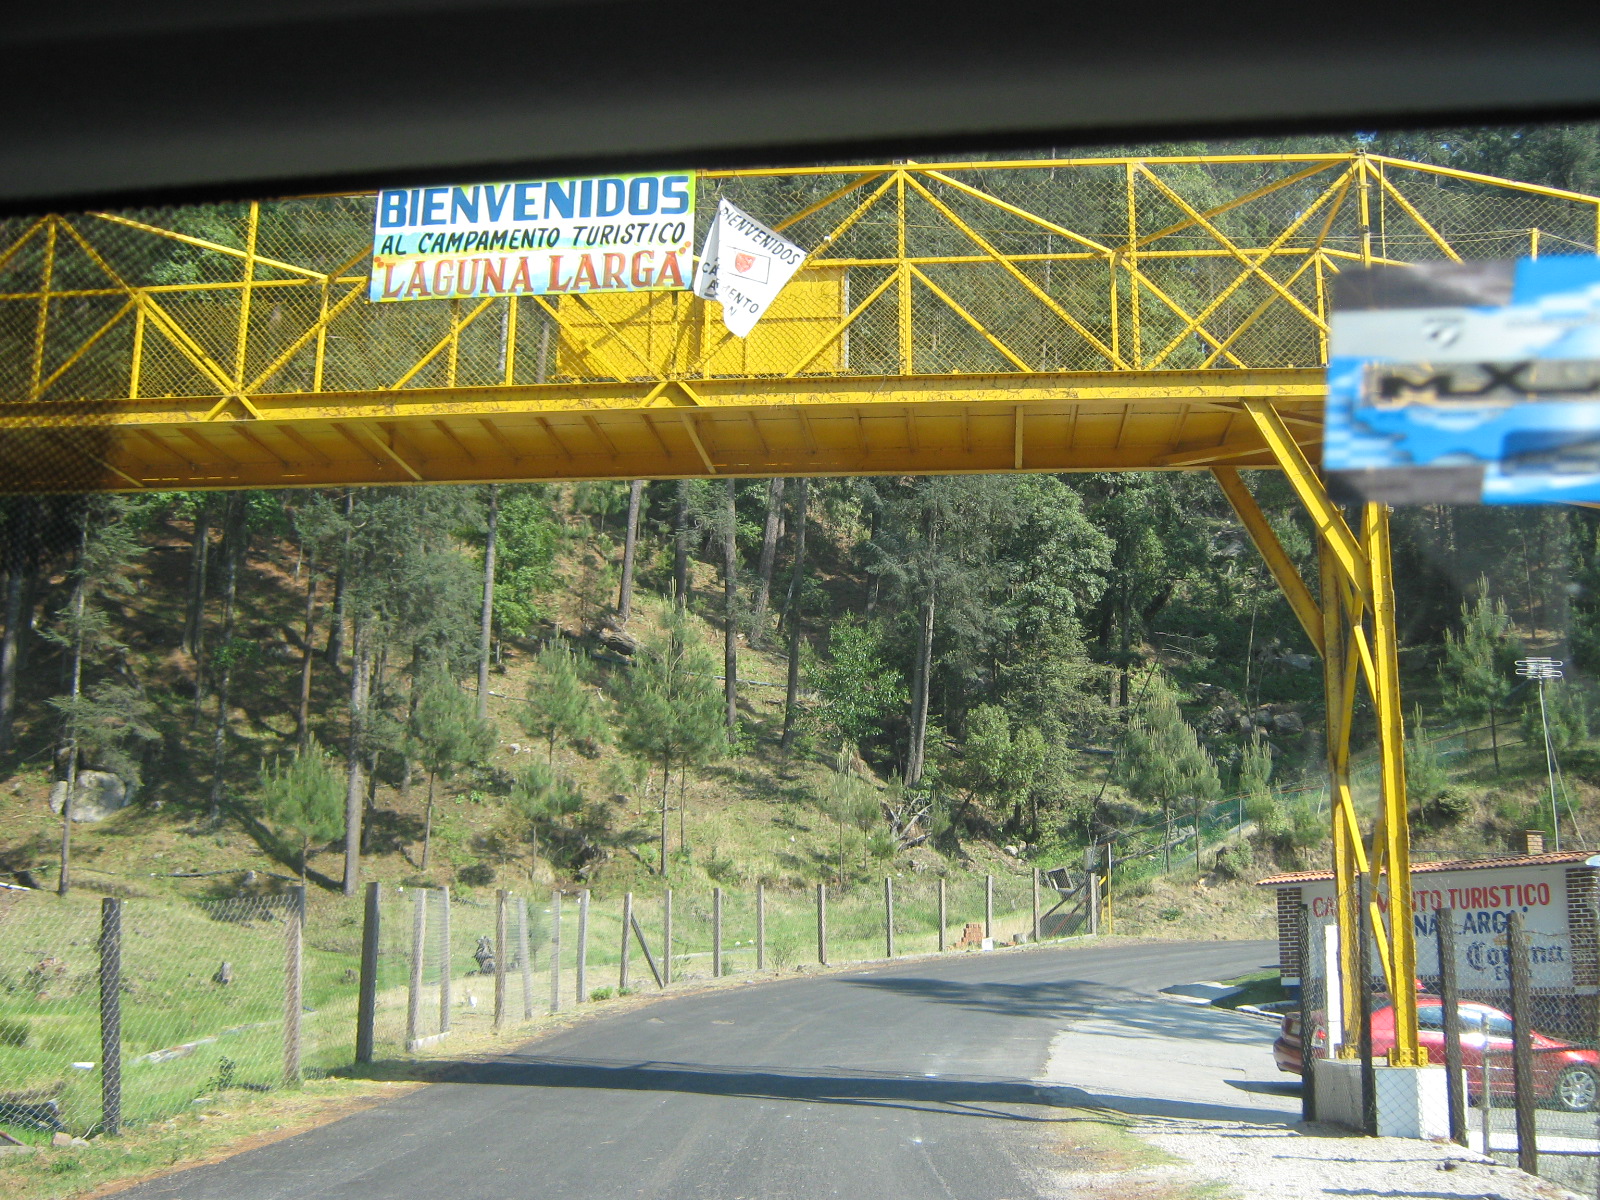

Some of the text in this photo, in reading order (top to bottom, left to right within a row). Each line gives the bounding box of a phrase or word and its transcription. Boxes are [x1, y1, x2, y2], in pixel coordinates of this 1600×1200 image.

[380, 175, 689, 228] BIENVENIDOS
[381, 221, 686, 255] AL CAMPAMENTO TURISTICO
[381, 250, 684, 299] LAGUNA LARGA
[1447, 882, 1550, 910] TURISTICO
